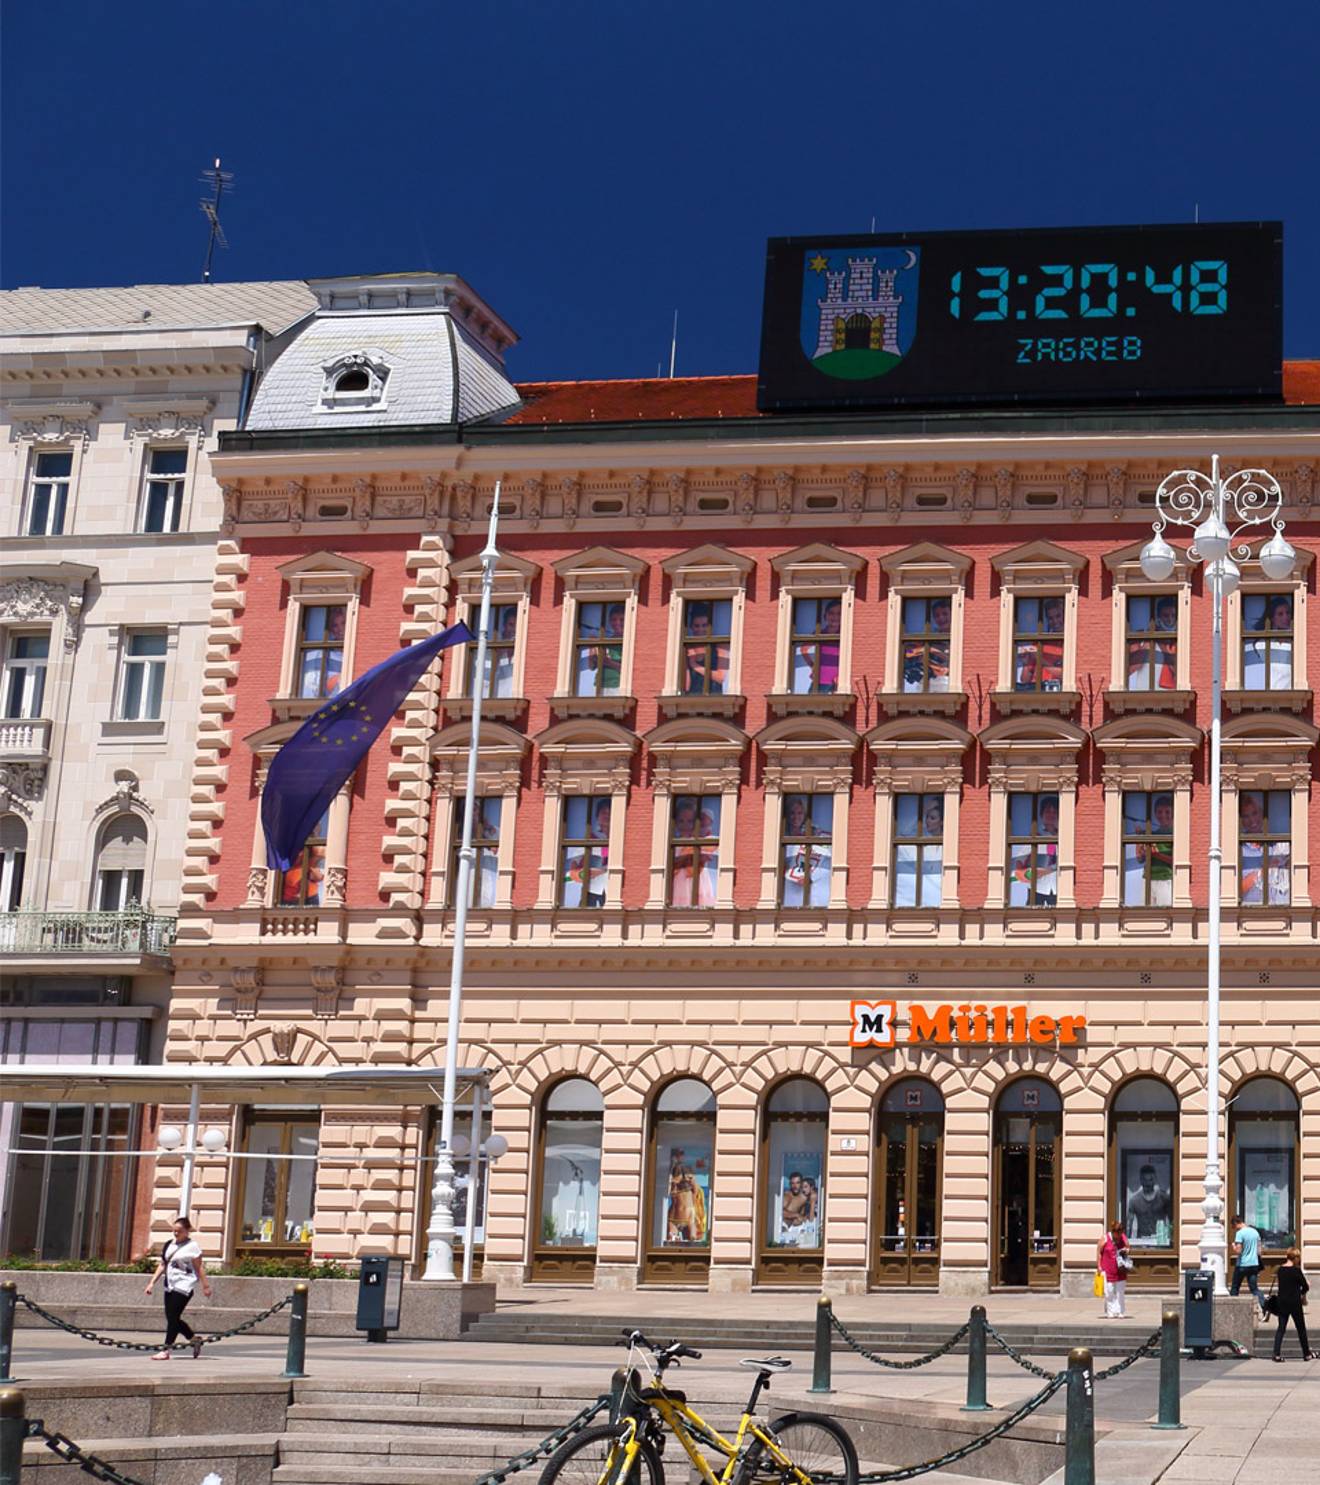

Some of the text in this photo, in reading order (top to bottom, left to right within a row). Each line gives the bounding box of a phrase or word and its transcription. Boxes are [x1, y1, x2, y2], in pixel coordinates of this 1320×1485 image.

[950, 260, 1228, 320] 13:20:48
[1016, 336, 1142, 363] ZAGREB
[908, 1004, 1087, 1044] Müller
